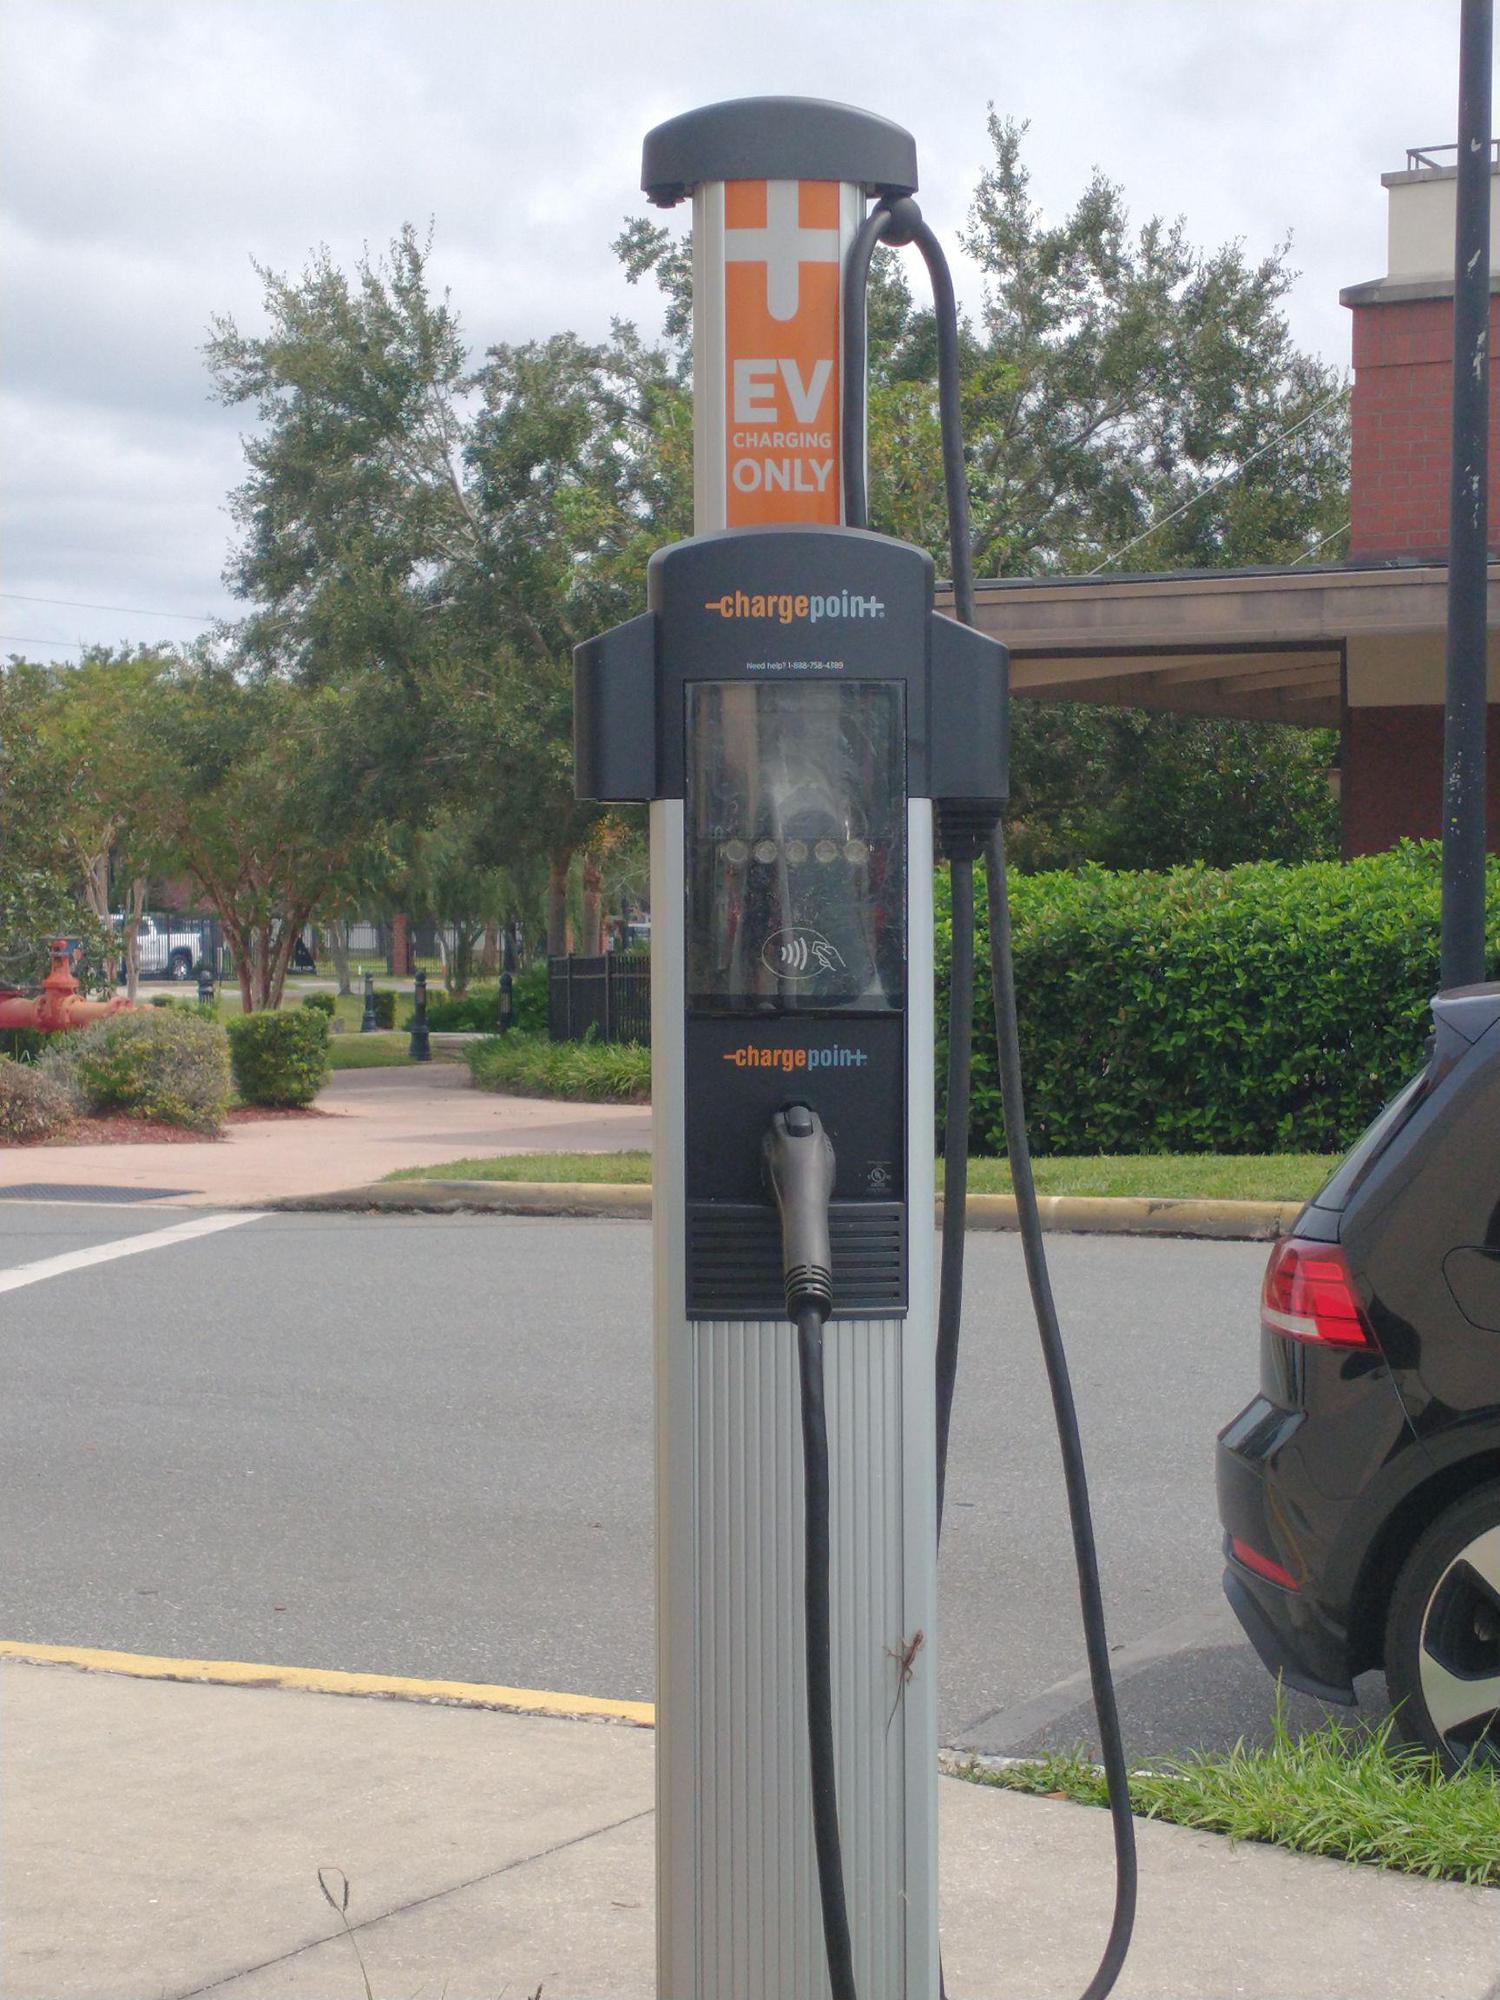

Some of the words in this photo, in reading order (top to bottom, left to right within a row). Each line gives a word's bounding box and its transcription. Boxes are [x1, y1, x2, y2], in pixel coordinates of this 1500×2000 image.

[733, 359, 834, 423] EV
[733, 432, 832, 448] CHARGING
[732, 458, 834, 492] ONLY
[746, 662, 766, 670] Need
[767, 662, 787, 671] help?
